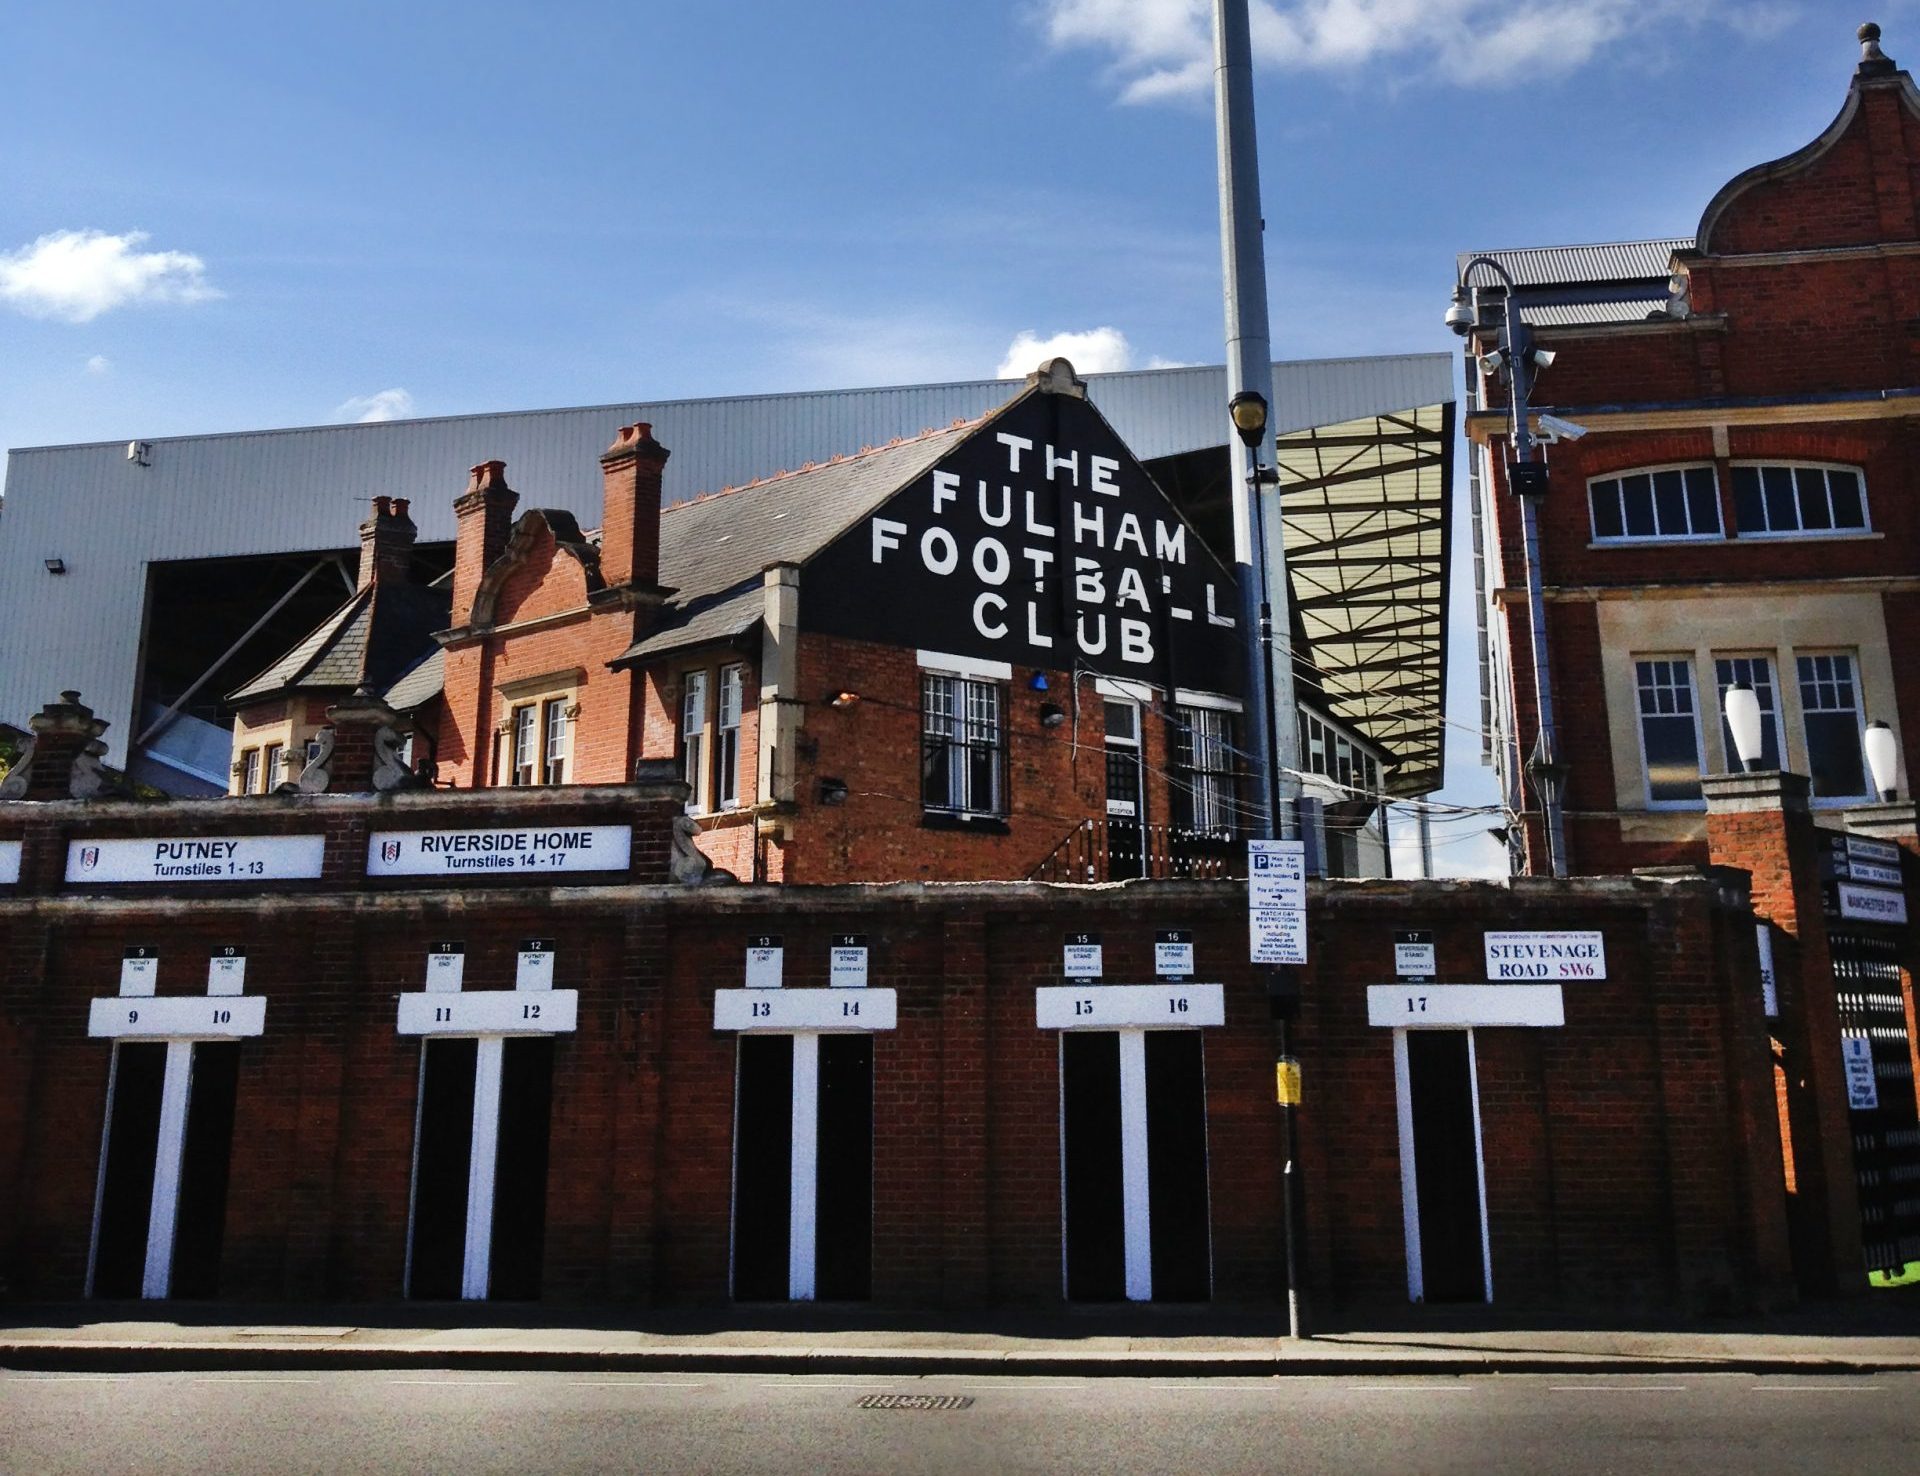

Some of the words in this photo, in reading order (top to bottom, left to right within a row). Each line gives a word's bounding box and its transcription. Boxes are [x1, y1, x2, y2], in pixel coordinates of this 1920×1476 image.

[997, 432, 1120, 497] THE
[933, 470, 1186, 565] FULHAM
[872, 517, 1235, 628] FOOTBALL
[973, 592, 1154, 664] CLUB
[421, 833, 527, 852] RIVERSIDE
[533, 832, 592, 849] HOME
[156, 841, 238, 860] PUTNEY
[445, 854, 514, 868] Turnstiles
[520, 854, 536, 866] 14
[550, 853, 566, 866] 17
[1257, 856, 1267, 868] P
[153, 863, 222, 877] Turnstiles
[228, 862, 235, 875] 1
[249, 862, 264, 875] 13
[760, 937, 770, 946] 13
[844, 936, 855, 944] 14
[1077, 935, 1088, 943] 15
[1168, 932, 1179, 941] 16
[1408, 933, 1419, 941] 17
[138, 948, 145, 956] 9
[224, 947, 235, 955] 10
[441, 943, 451, 952] 11
[531, 941, 542, 950] 12
[1490, 944, 1599, 958] STEVENAGE
[1500, 963, 1548, 977] ROAD
[1559, 963, 1594, 976] SW6
[752, 1002, 771, 1017] 13
[843, 1002, 860, 1016] 14
[1075, 1000, 1093, 1015] 15
[1169, 998, 1188, 1013] 16
[1407, 997, 1427, 1012] 17
[128, 1010, 139, 1024] 9
[213, 1010, 231, 1024] 10
[435, 1007, 451, 1022] 11
[523, 1005, 540, 1019] 12
